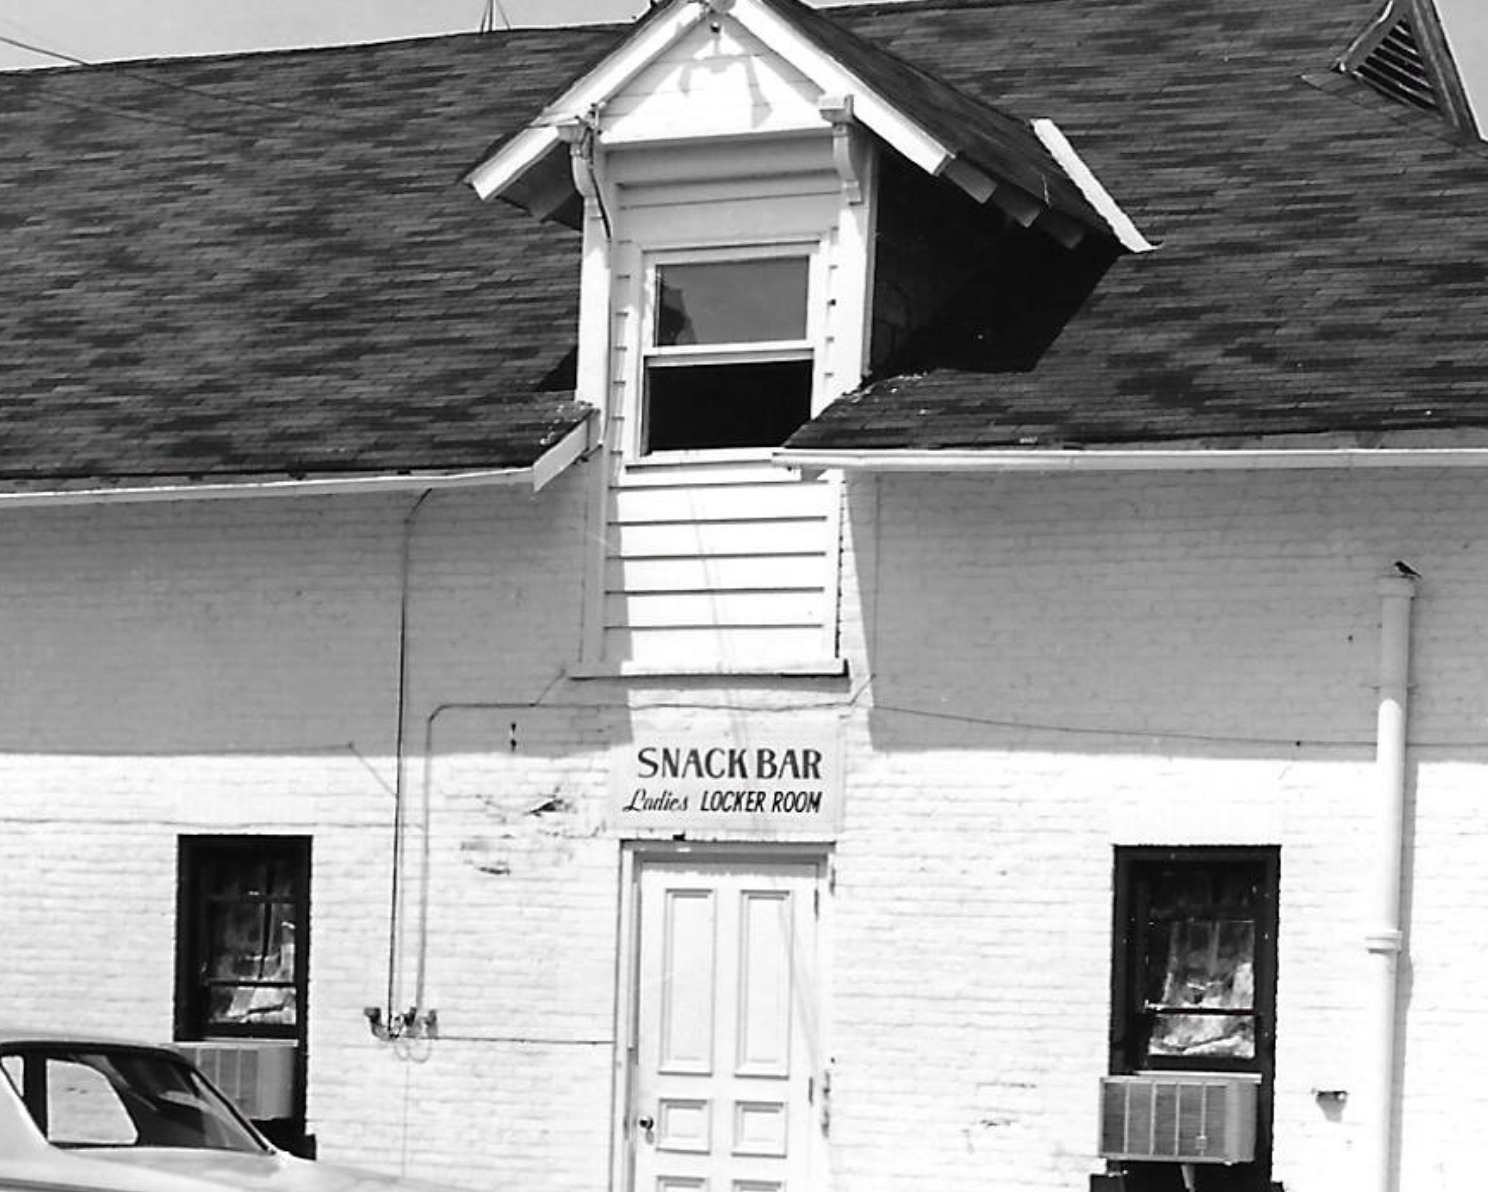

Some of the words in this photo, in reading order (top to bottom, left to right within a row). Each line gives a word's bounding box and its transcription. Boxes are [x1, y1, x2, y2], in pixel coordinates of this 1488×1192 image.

[638, 747, 749, 779] SNACK
[756, 748, 823, 780] BAR
[623, 788, 688, 812] Ladies
[700, 790, 766, 812] LOCKER
[771, 790, 823, 813] ROOM
